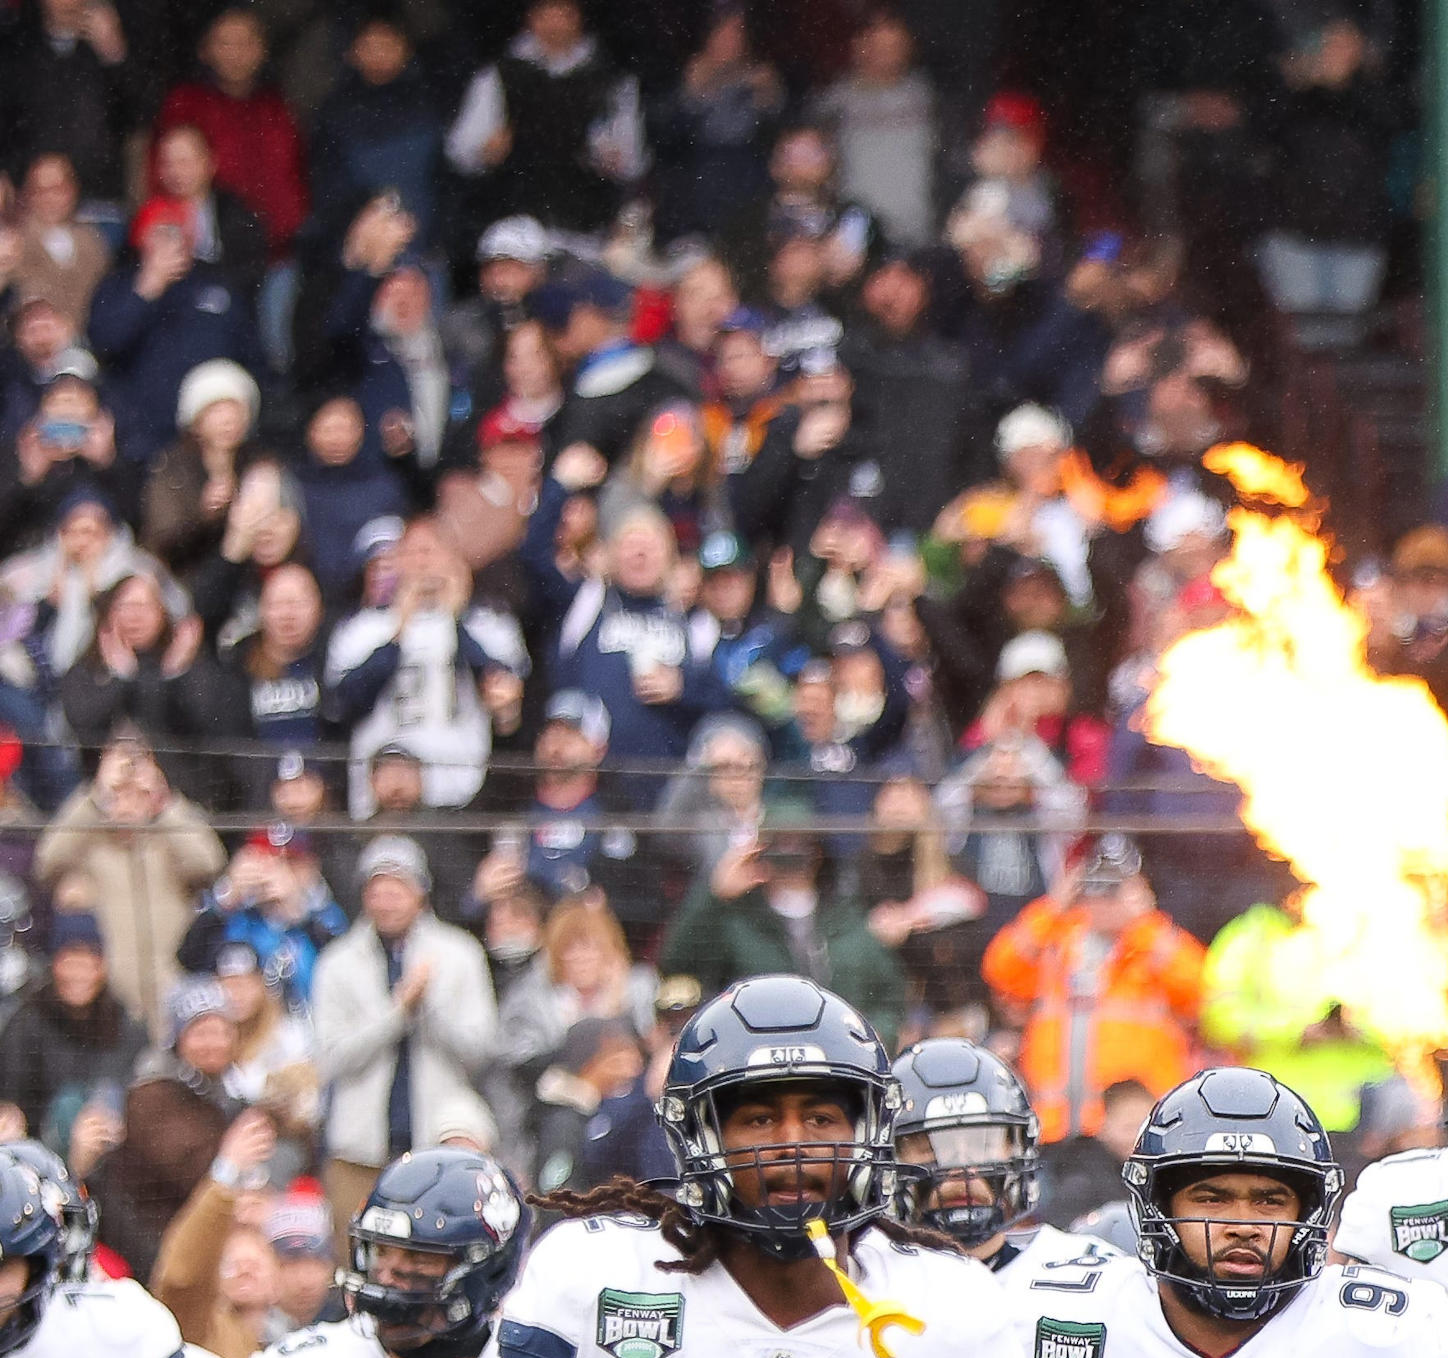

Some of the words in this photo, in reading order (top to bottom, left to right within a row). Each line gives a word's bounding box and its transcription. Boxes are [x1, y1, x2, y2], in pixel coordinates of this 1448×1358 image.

[1226, 1289, 1256, 1299] UCONN
[616, 1308, 665, 1320] FENWAY
[603, 1315, 676, 1349] BOWL
[1050, 1333, 1091, 1347] FENWAY
